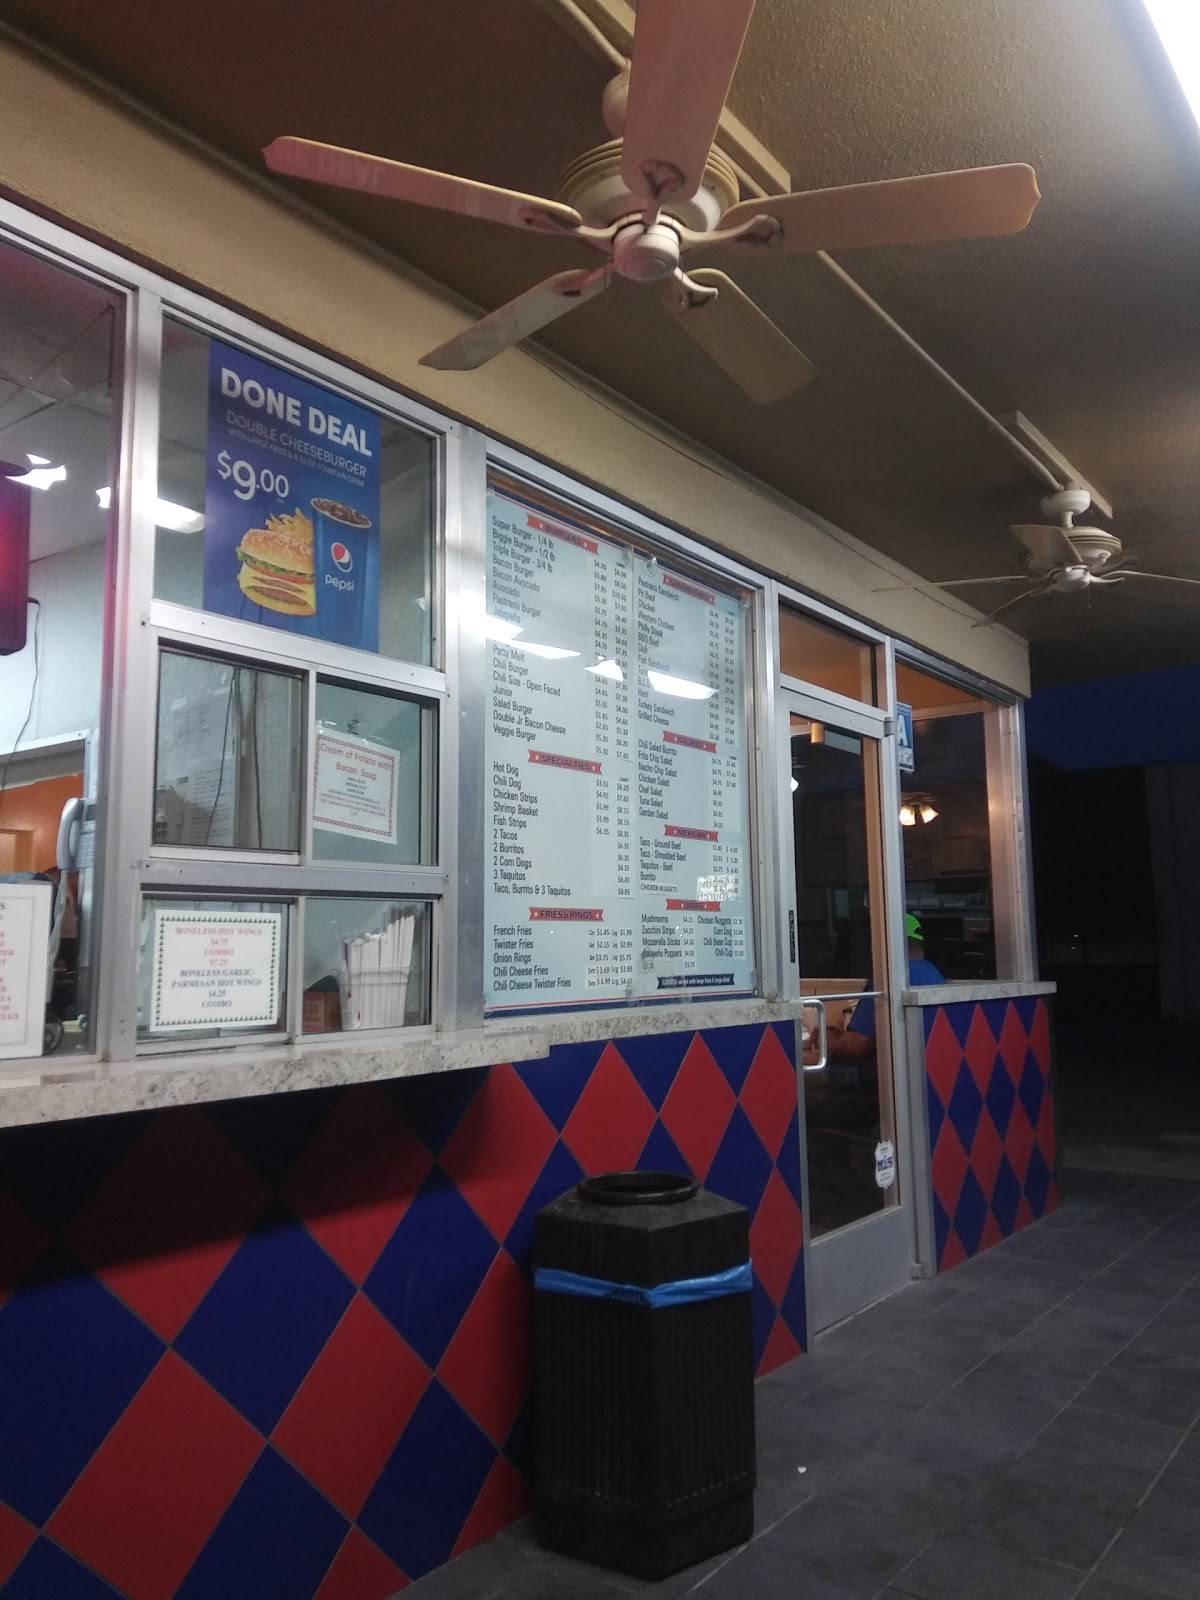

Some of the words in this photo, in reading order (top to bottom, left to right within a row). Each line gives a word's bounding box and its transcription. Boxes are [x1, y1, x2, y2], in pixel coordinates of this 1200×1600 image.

[222, 367, 301, 426] DONE
[308, 406, 372, 456] DEAL
[226, 410, 277, 441] DOUBLE
[280, 433, 367, 476] CHEESEBURGER
[217, 450, 289, 500] $9.00
[493, 515, 510, 535] Super
[512, 524, 532, 542] Burger
[538, 535, 547, 546] 1/4
[493, 528, 511, 547] Biggie
[514, 537, 533, 556] Burger
[540, 548, 548, 559] 1/2
[492, 541, 509, 558] Triple
[511, 549, 530, 566] Burger
[492, 554, 512, 570] Bacon
[514, 562, 534, 579] Burger
[325, 574, 354, 591] pepsi
[492, 567, 512, 582] Bacon
[514, 575, 540, 592] Avocado
[493, 581, 520, 598] Avocado
[522, 603, 541, 620] Burger
[638, 621, 650, 634] Philly
[493, 645, 509, 661] Patty
[511, 650, 524, 662] Melt
[494, 658, 506, 670] Chili
[509, 662, 528, 678] Burger
[494, 672, 506, 683] Chili
[508, 676, 521, 687] Size
[527, 681, 542, 694] Open
[544, 685, 560, 697] Faced
[493, 685, 512, 698] Junior
[493, 698, 510, 710] Salad
[512, 702, 532, 716] Burger
[638, 699, 652, 711] Turkey
[494, 711, 514, 724] Double
[525, 718, 543, 730] Bacon
[545, 722, 566, 735] Cheese
[638, 711, 652, 722] Grilled
[653, 714, 669, 726] Cheese
[494, 724, 514, 738] Veggie
[516, 729, 536, 742] Burger
[897, 714, 908, 747] A
[639, 739, 648, 749] Chili
[649, 742, 661, 753] Salad
[663, 745, 677, 756] Burrito
[320, 743, 343, 756] Cream
[345, 750, 353, 758] of
[355, 753, 376, 766] Potato
[661, 756, 672, 766] Salad
[542, 754, 589, 771] SPECIALTIES
[336, 762, 358, 774] Bacon
[360, 768, 376, 781] Soup
[493, 762, 503, 773] Hot
[505, 764, 519, 777] Dog
[639, 762, 652, 773] Nacho
[654, 766, 663, 776] Chip
[665, 768, 677, 778] Salad
[494, 775, 507, 786] Chili
[509, 778, 521, 790] Dog
[639, 774, 656, 785] Chicken
[657, 778, 670, 787] Salad
[494, 789, 518, 801] Chicken
[520, 793, 537, 805] Strips
[639, 785, 649, 794] Chef
[650, 787, 662, 797] Salad
[651, 798, 663, 807] Salad
[494, 803, 516, 816] Shrimp
[518, 806, 538, 817] Basket
[639, 808, 655, 818] Garden
[656, 810, 668, 819] Salad
[494, 816, 507, 827] Fish
[509, 818, 526, 830] Strips
[500, 830, 517, 841] Tacos
[500, 843, 524, 854] Burritos
[640, 838, 650, 846] Taco
[654, 840, 670, 849] Ground
[671, 842, 681, 850] Beef
[640, 849, 650, 858] Taco
[655, 851, 675, 861] Shredded
[677, 853, 686, 861] Beef
[500, 857, 514, 867] Corn
[516, 858, 532, 870] Dogs
[640, 861, 659, 871] Taquitos
[663, 863, 673, 871] Beef
[500, 870, 525, 882] Taquitos
[494, 884, 510, 895] Taco,
[513, 885, 533, 894] Burrito
[548, 886, 571, 897] Taquitos
[642, 914, 668, 923] Mushrooms
[698, 916, 713, 924] Chicken
[715, 917, 731, 926] Nuggets
[176, 927, 216, 936] BONELESS
[218, 927, 235, 936] HOT
[238, 927, 262, 936] WINGS
[494, 925, 515, 936] French
[517, 926, 532, 936] Fries
[642, 926, 661, 935] Zucchini
[662, 926, 675, 936] Strips
[494, 939, 515, 950] Twister
[518, 939, 533, 950] Fries
[642, 938, 666, 947] Mozzarella
[667, 938, 680, 946] Sticks
[204, 948, 235, 956] COMBO
[664, 949, 681, 959] Poppers
[494, 953, 512, 964] Onion
[514, 953, 531, 965] Rings
[180, 969, 220, 978] BONELESS
[494, 967, 508, 978] Chili
[510, 966, 532, 978] Cheese
[534, 965, 548, 976] Fries
[172, 980, 216, 988] PARMESAN
[217, 980, 234, 988] HOT
[237, 978, 262, 986] WINGS
[493, 981, 507, 992] Chili
[510, 980, 533, 992] Cheese
[534, 978, 556, 990] Twister
[558, 978, 571, 988] Fries
[201, 1000, 232, 1008] COMBO
